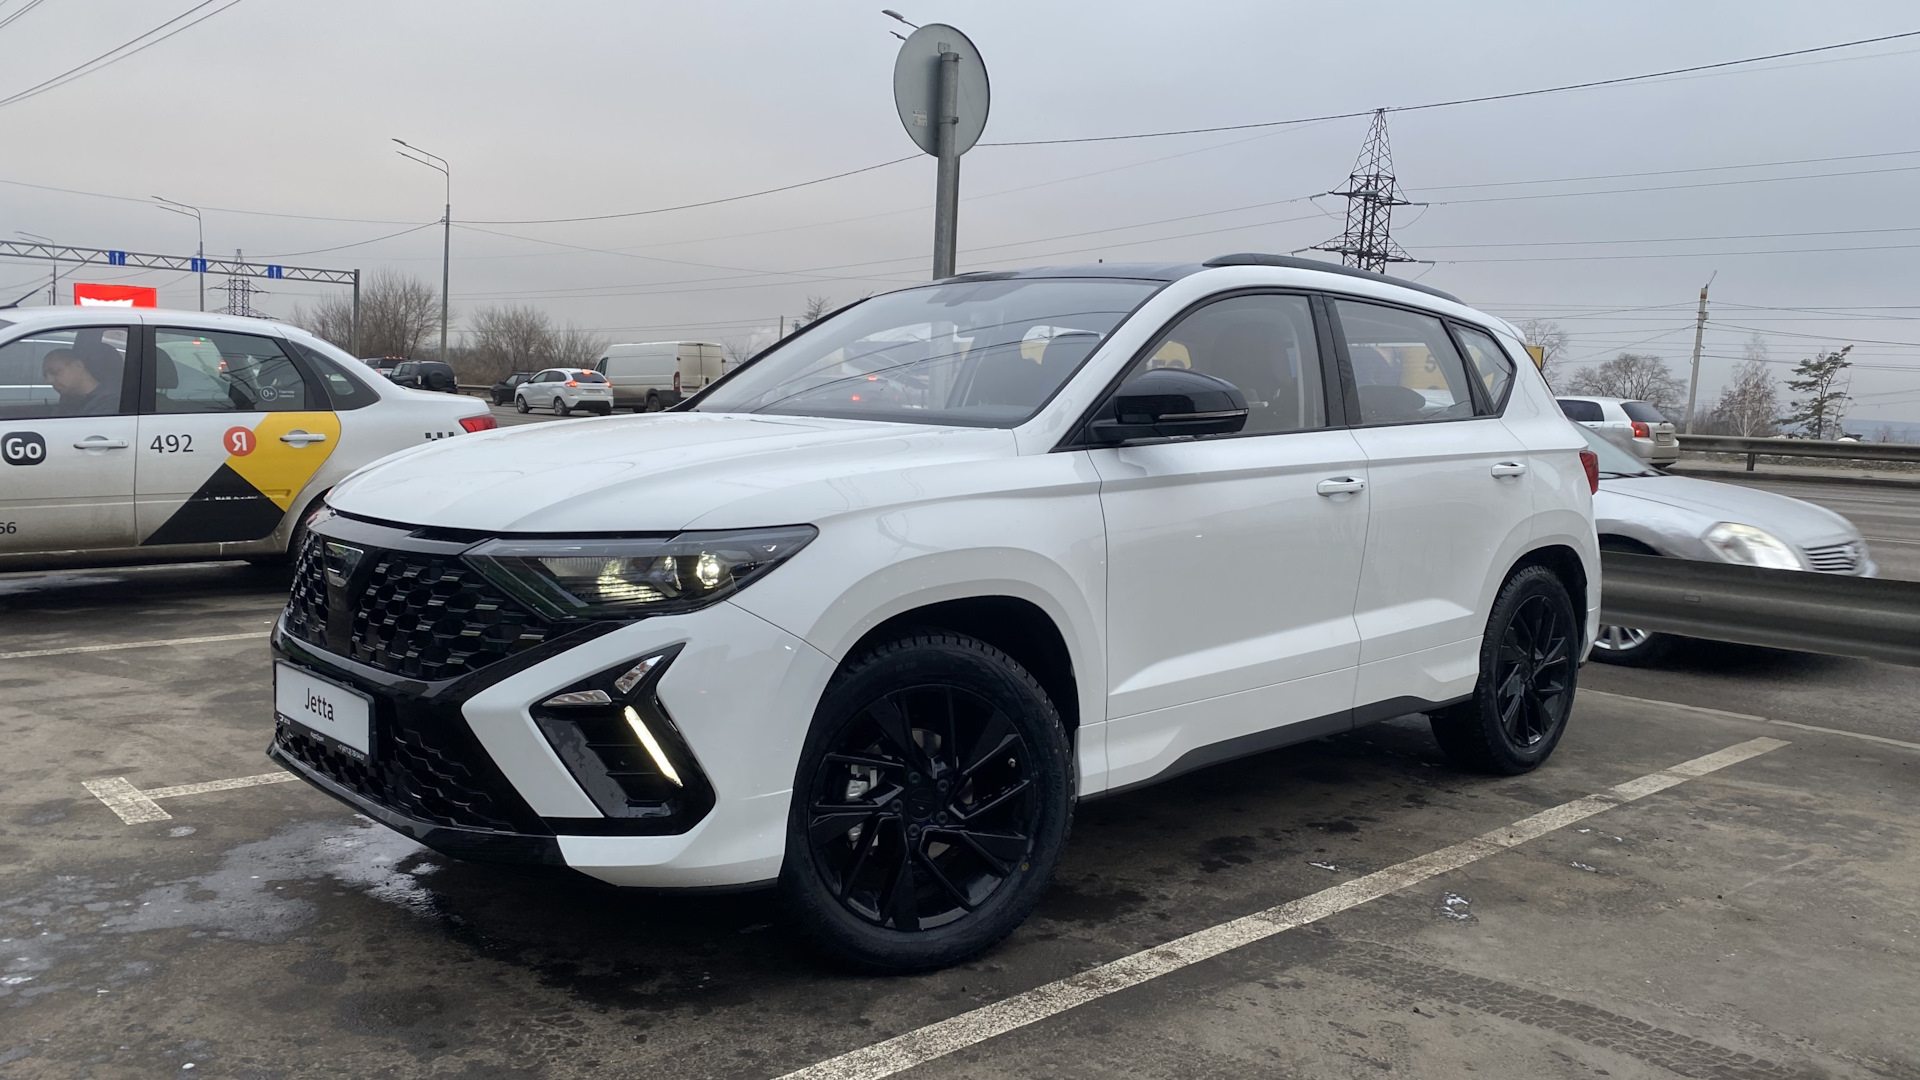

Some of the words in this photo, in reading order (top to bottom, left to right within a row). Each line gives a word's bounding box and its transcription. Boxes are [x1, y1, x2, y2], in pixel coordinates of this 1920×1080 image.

[263, 389, 274, 397] 0+
[6, 438, 42, 460] Go
[150, 434, 194, 453] 492
[231, 431, 248, 451] Я
[304, 687, 335, 722] Jetta
